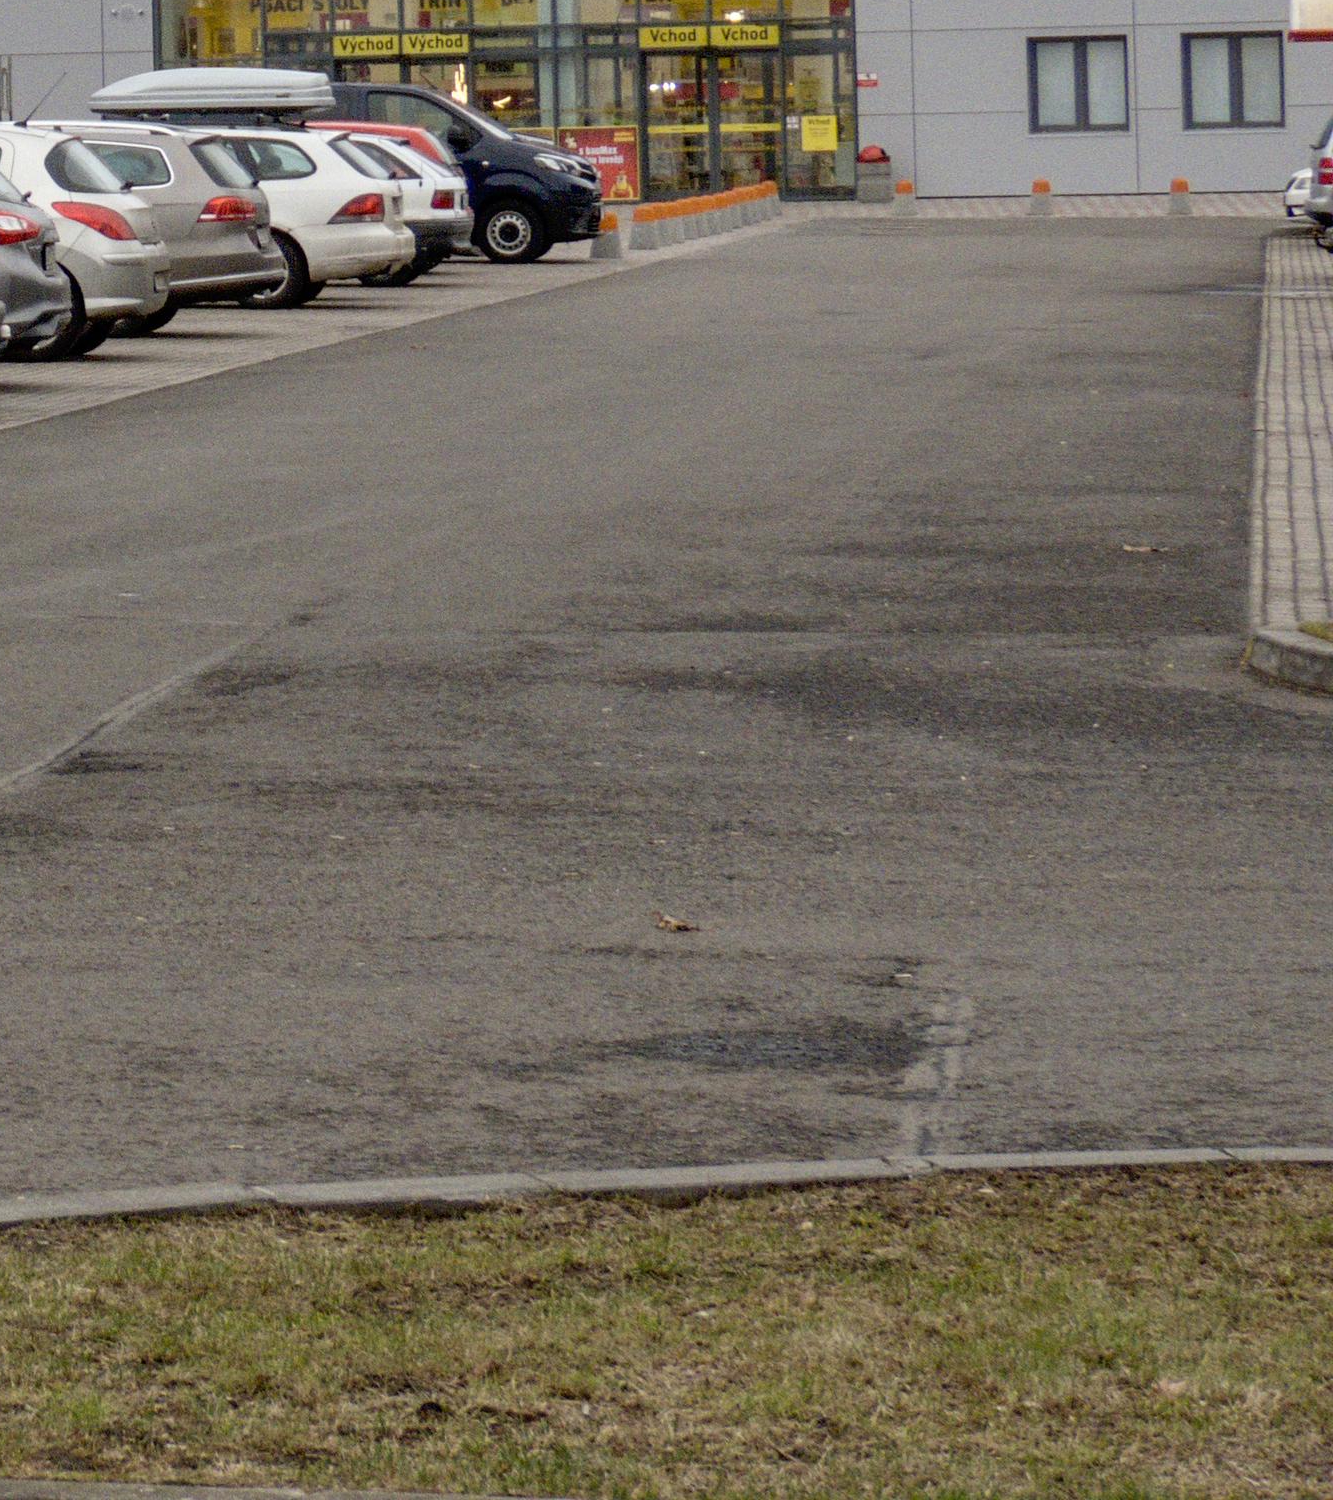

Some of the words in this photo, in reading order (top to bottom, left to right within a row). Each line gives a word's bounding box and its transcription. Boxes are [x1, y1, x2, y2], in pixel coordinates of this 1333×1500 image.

[649, 30, 696, 42] Vchod
[721, 27, 768, 41] Vchod
[340, 37, 393, 53] Východ
[408, 35, 463, 50] Východ
